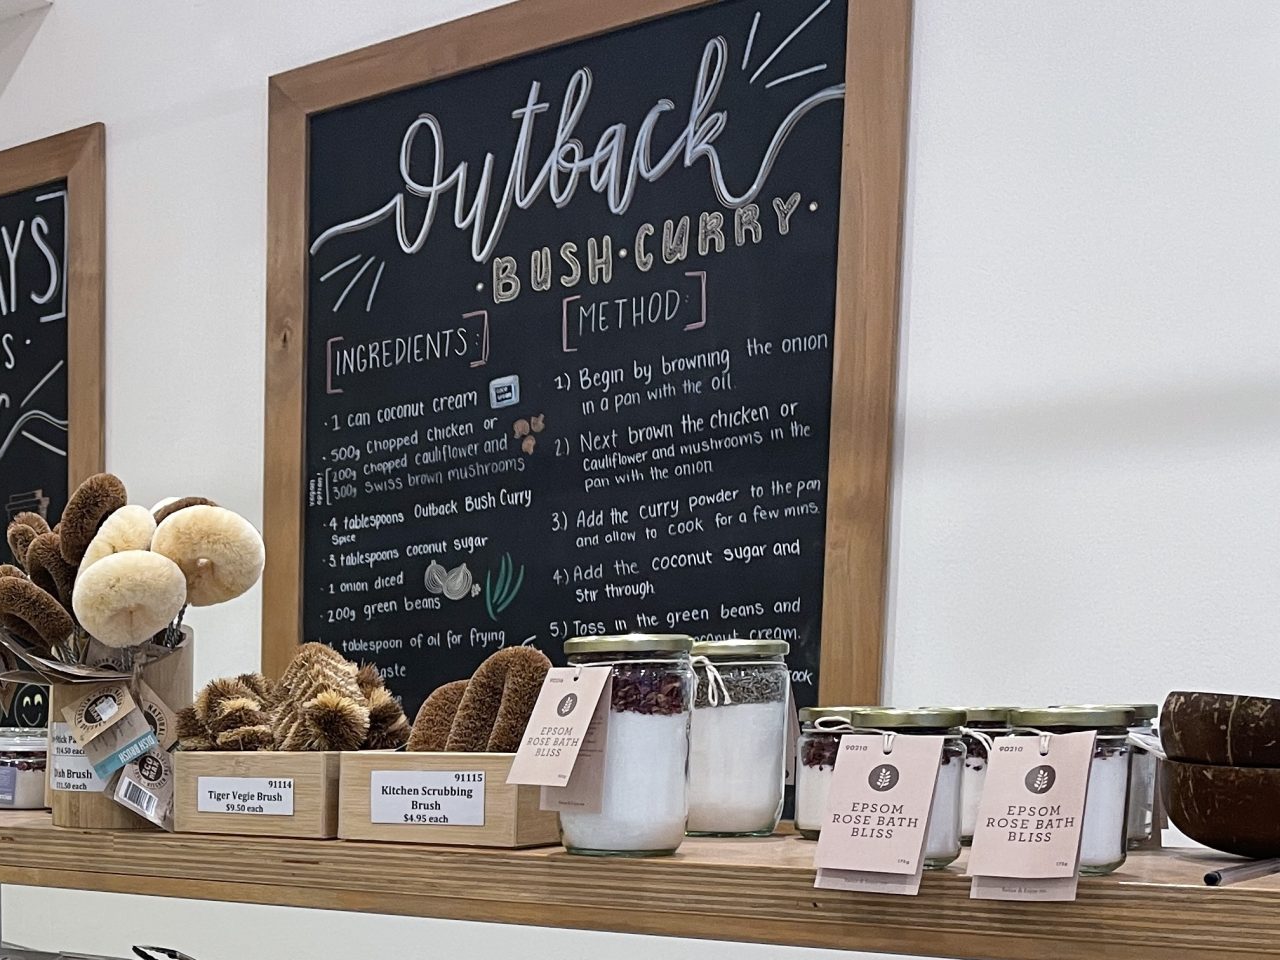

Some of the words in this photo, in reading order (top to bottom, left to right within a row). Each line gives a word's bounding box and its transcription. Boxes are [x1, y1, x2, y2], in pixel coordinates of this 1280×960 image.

[388, 36, 734, 262] Outback
[493, 235, 614, 304] BUSH
[634, 191, 802, 275] CURRY
[577, 366, 625, 393] Begin
[633, 360, 652, 385] by
[661, 348, 731, 374] browning
[746, 337, 773, 357] the
[781, 333, 829, 353] onion
[347, 411, 371, 427] can
[377, 401, 425, 423] coconut
[432, 390, 479, 412] cream
[581, 399, 595, 416] in
[614, 390, 642, 413] pan
[646, 383, 677, 401] with
[683, 378, 703, 396] the
[579, 429, 619, 453] Next
[628, 422, 675, 446] brown
[681, 413, 705, 435] the
[709, 404, 770, 430] chicken
[780, 400, 800, 417] or
[330, 445, 361, 464] 500g
[427, 421, 474, 443] chicken
[483, 415, 499, 430] or
[414, 442, 480, 465] cauliflower
[484, 433, 508, 453] and
[651, 443, 677, 461] and
[680, 430, 764, 456] mushrooms
[770, 425, 785, 441] in
[790, 420, 812, 438] the
[407, 469, 443, 488] brown
[447, 456, 526, 483] mushrooms
[584, 475, 611, 493] pan
[615, 468, 645, 485] with
[650, 465, 670, 480] the
[674, 458, 714, 477] onion
[343, 511, 405, 530] tablespoons
[414, 500, 459, 519] Outback
[465, 492, 497, 512] Bush
[499, 488, 533, 508] Curry
[576, 509, 605, 529] Add
[610, 507, 630, 525] the
[689, 488, 740, 511] powder
[750, 484, 765, 499] to
[771, 479, 793, 497] the
[796, 478, 821, 498] pan
[576, 533, 600, 549] and
[604, 530, 637, 544] allow
[645, 526, 658, 541] to
[667, 517, 705, 537] cook
[715, 513, 734, 529] for
[752, 504, 780, 524] few
[331, 532, 357, 547] Spice
[340, 548, 400, 568] tablespoons
[406, 540, 447, 557] coconut
[453, 535, 489, 554] sugar
[573, 564, 604, 584] Add
[613, 559, 640, 576] the
[651, 549, 713, 572] coconut
[723, 543, 769, 564] sugar
[772, 538, 801, 556] and
[340, 580, 369, 593] onion
[374, 570, 405, 590] diced
[327, 606, 357, 623] 200g
[363, 599, 398, 621] green
[404, 595, 442, 612] beans
[572, 619, 606, 636] Toss
[614, 618, 627, 632] in
[636, 612, 660, 629] the
[666, 607, 710, 629] green
[720, 602, 764, 620] beans
[773, 596, 802, 614] and
[342, 635, 403, 654] tablespoon
[409, 633, 424, 648] of
[427, 632, 441, 647] oil
[446, 629, 463, 645] for
[469, 627, 506, 648] frying
[526, 737, 552, 747] ROSE
[553, 737, 580, 747] BATH
[540, 726, 574, 736] EPSOM
[534, 748, 562, 757] BLISS
[67, 768, 93, 780] Brush
[268, 780, 292, 790] 91114
[454, 773, 484, 784] 91115
[72, 782, 88, 790] each
[207, 790, 231, 803] Tiger
[232, 790, 256, 803] Vegie
[257, 791, 283, 803] Brush
[380, 785, 420, 797] Kitchen
[421, 785, 474, 799] Scrubbing
[225, 803, 245, 813] $9.50
[246, 803, 264, 814] each
[411, 799, 442, 812] Brush
[850, 801, 905, 815] EPSOM
[1006, 804, 1062, 817] EPSOM
[403, 812, 428, 824] $4.95
[428, 813, 449, 824] each
[831, 813, 874, 827] ROSE
[876, 815, 919, 829] BATH
[985, 817, 1029, 830] ROSE
[1035, 816, 1076, 830] BATH
[850, 827, 894, 840] BLISS
[1006, 830, 1053, 843] BLISS
